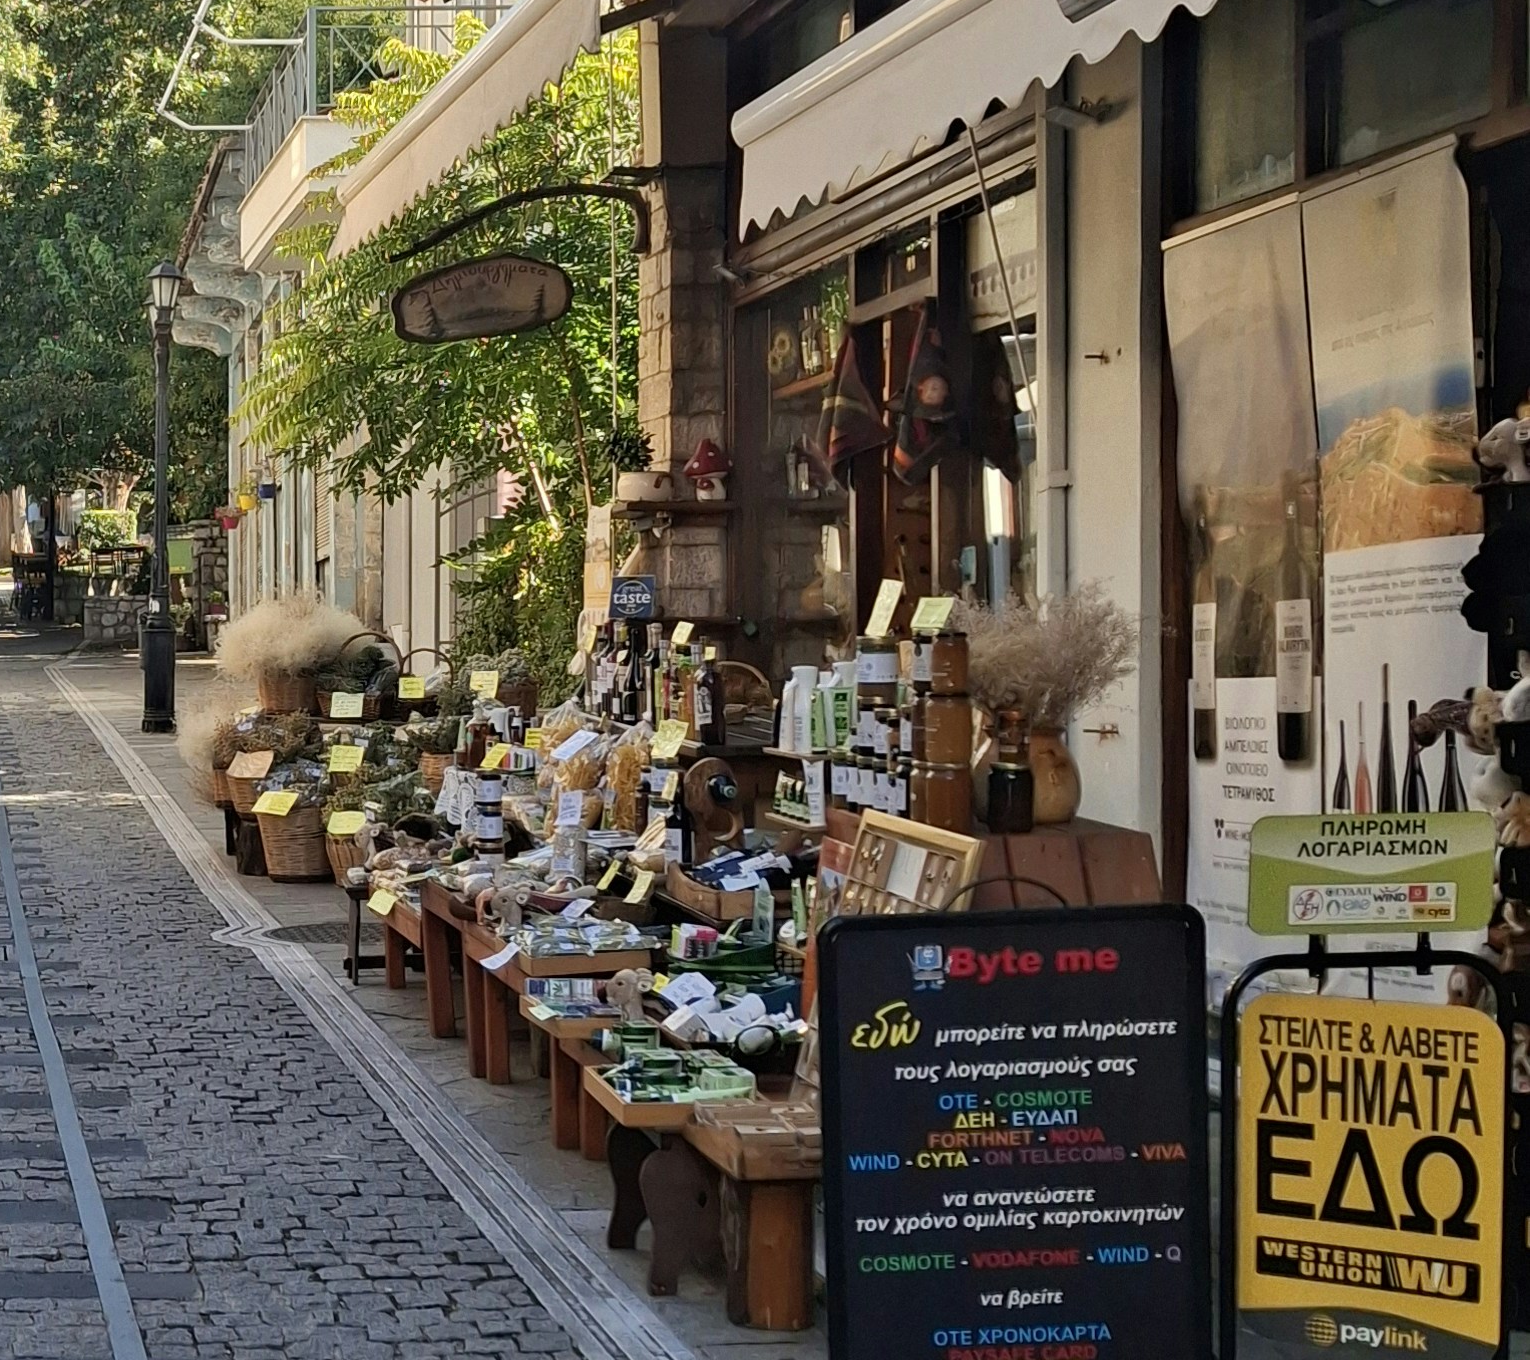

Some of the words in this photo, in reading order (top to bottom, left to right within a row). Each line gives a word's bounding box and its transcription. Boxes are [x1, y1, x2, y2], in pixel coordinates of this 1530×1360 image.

[613, 593, 651, 604] taste
[1222, 785, 1275, 802] ΤΕΤΡΑΜΥΘΟΣ
[1321, 819, 1426, 837] ΠΛΗΡΩΜΗ
[1297, 839, 1448, 858] ΛΟΓΑΡΙΑΣΜΩΝ
[1373, 893, 1407, 902] WIND
[947, 946, 1044, 985] Byte
[1055, 946, 1120, 973] me
[851, 998, 921, 1049] εδώ
[935, 1022, 1026, 1047] μπορείτε
[1031, 1025, 1056, 1040] να
[1063, 1018, 1177, 1041] πληρώσετε
[1258, 1014, 1353, 1052] ΣΤΕΙΛΤΕ
[1359, 1023, 1376, 1054] &
[1382, 1024, 1479, 1064] ΛΑΒΕΤΕ
[895, 1061, 941, 1083] τους
[945, 1056, 1093, 1080] λογαριασμούς
[1097, 1055, 1138, 1076] σας
[995, 1089, 1093, 1108] COSMOTE
[1259, 1049, 1483, 1137] ΧΡΗΜΑΤΑ
[954, 1111, 995, 1129] ΔΕΗ
[1012, 1109, 1078, 1126] ΕΥΔΑΠ
[928, 1130, 1034, 1148] FORTHNET
[1049, 1127, 1105, 1144] NOVA
[849, 1154, 900, 1171] WIND
[917, 1150, 968, 1169] CYTA
[985, 1149, 1013, 1166] ON
[1021, 1145, 1125, 1164] TELECOMS
[1141, 1144, 1186, 1162] VIVA
[1256, 1117, 1481, 1240] ΕΔΩ
[943, 1192, 966, 1208] να
[973, 1186, 1096, 1206] ανανεώσετε
[856, 1217, 888, 1232] τον
[893, 1211, 957, 1235] χρόνο
[963, 1209, 1038, 1231] ομιλίας
[1043, 1203, 1184, 1228] καρτοκινητών
[859, 1254, 956, 1273] COSMOTE
[972, 1250, 1080, 1269] VODAFONE
[1097, 1246, 1149, 1264] WIND
[1167, 1246, 1182, 1262] Q
[1263, 1240, 1382, 1270] WESTERN
[1299, 1258, 1382, 1286] UNION
[1394, 1257, 1467, 1297] WU
[980, 1292, 1002, 1306] να
[1007, 1289, 1063, 1310] βρείτε
[978, 1324, 1111, 1344] ΧΡΟΝΟΚΑΡΤΑ
[1340, 1323, 1428, 1352] paylink
